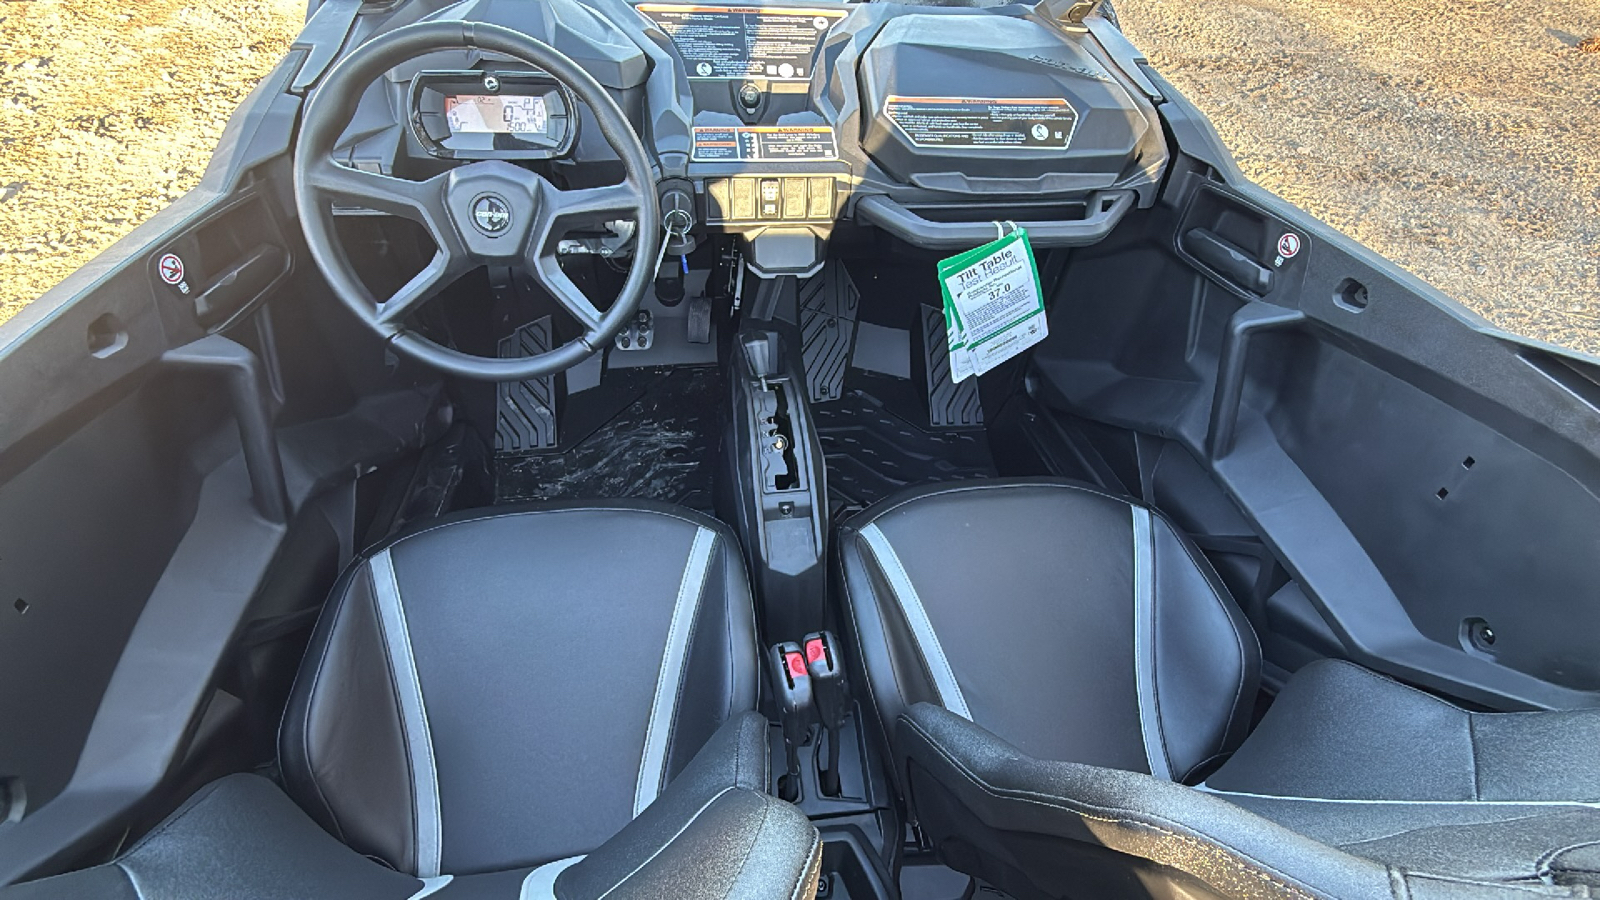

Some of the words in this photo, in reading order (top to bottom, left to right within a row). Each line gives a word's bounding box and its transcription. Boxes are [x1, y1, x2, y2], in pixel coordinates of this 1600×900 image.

[956, 267, 978, 283] Tilt
[979, 249, 1013, 271] Table
[958, 274, 982, 291] Test
[984, 254, 1019, 279] Result
[987, 282, 1011, 301] 37.0
